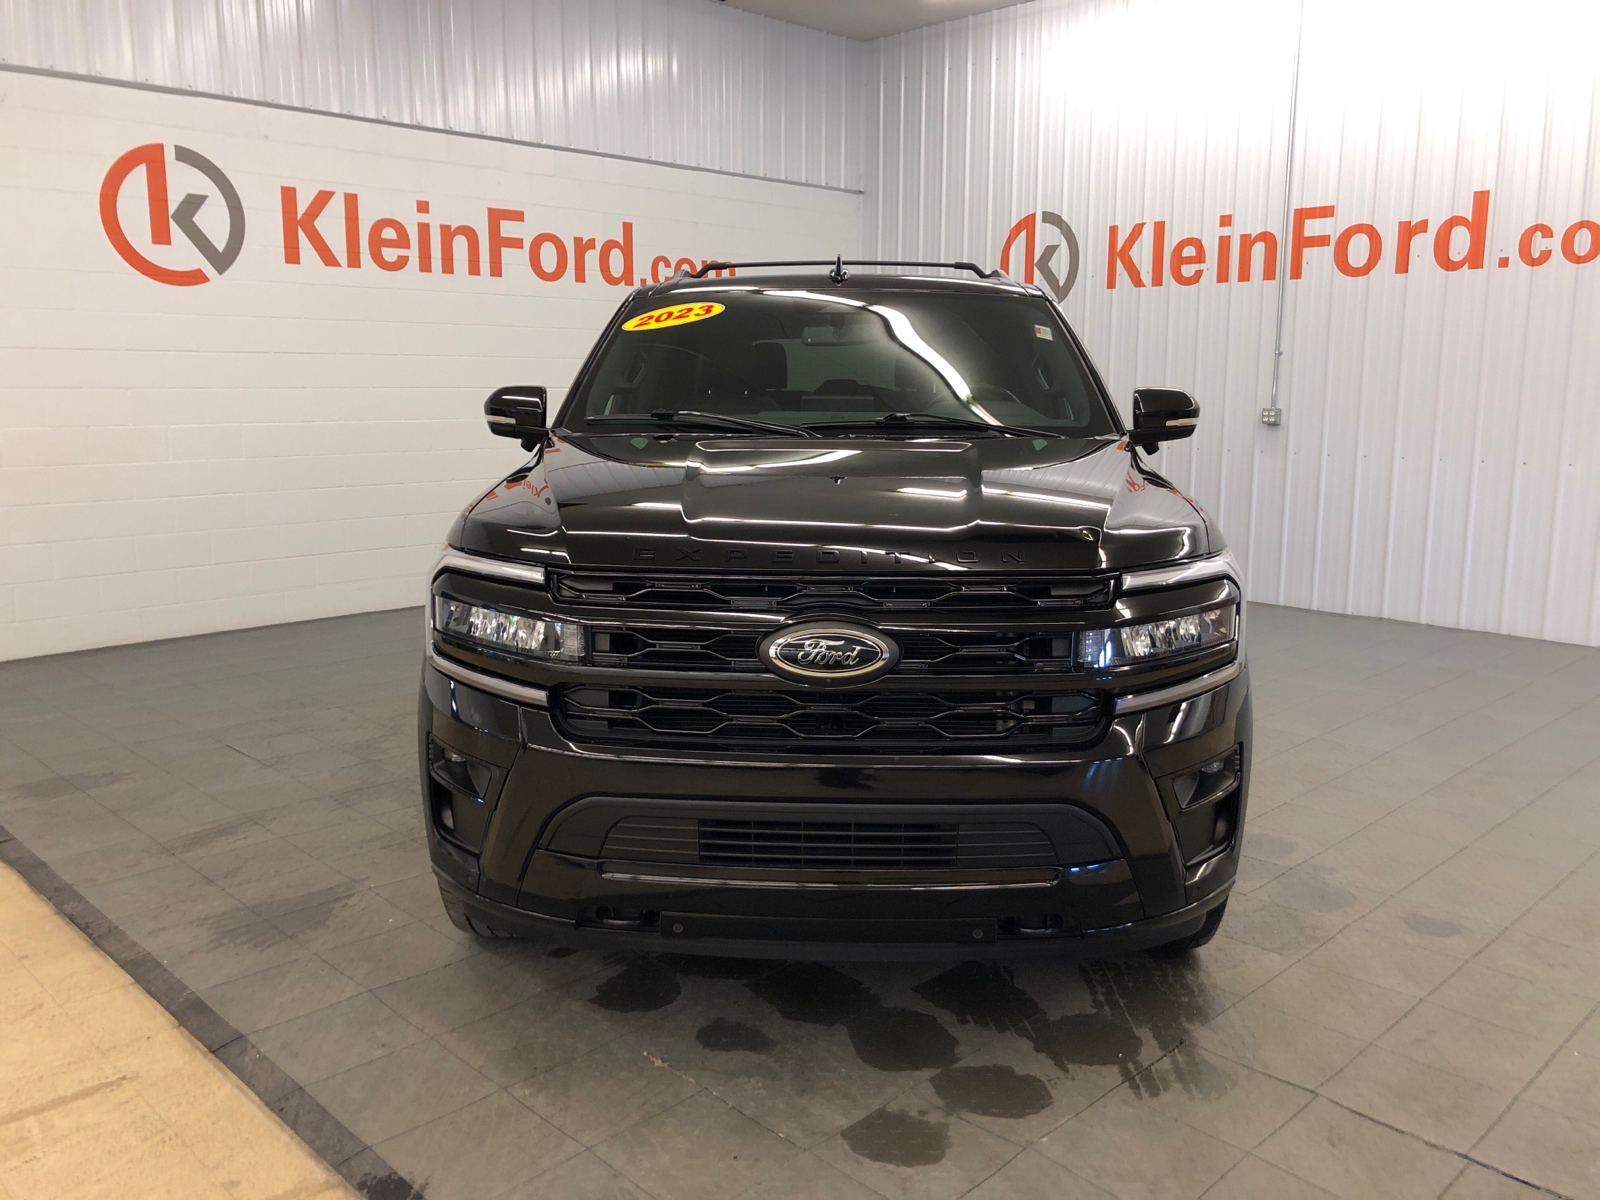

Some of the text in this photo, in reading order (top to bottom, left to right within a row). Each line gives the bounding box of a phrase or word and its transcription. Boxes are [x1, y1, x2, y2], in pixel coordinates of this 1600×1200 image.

[1106, 189, 1600, 290] KleinFord.co
[632, 304, 715, 329] 2023
[632, 546, 1026, 564] EXPEDITION
[797, 638, 860, 666] Ford
